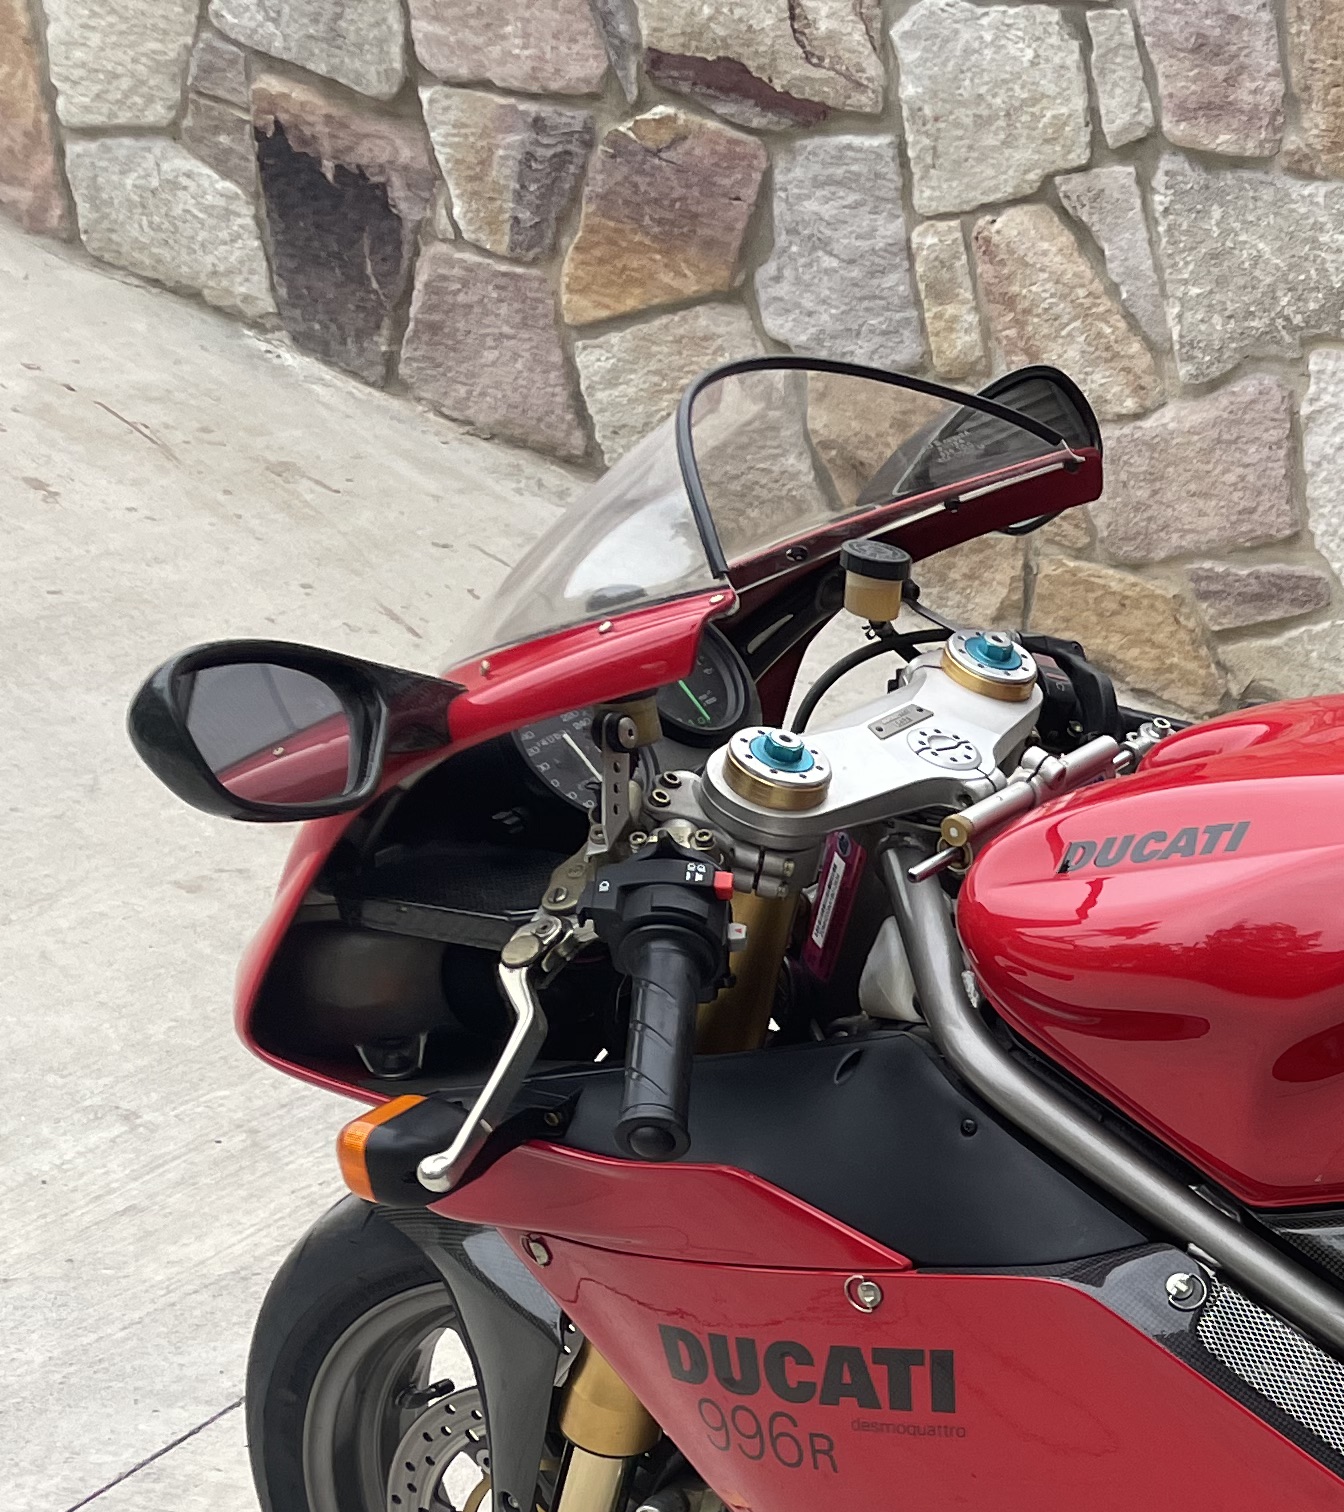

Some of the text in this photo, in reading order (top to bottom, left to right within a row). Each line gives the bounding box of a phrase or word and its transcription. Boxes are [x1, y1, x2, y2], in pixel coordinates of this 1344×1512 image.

[1056, 821, 1251, 875] DUCATI
[657, 1323, 957, 1414] DUCATI
[697, 1397, 839, 1474] 996R
[850, 1417, 967, 1439] desmoquattro
